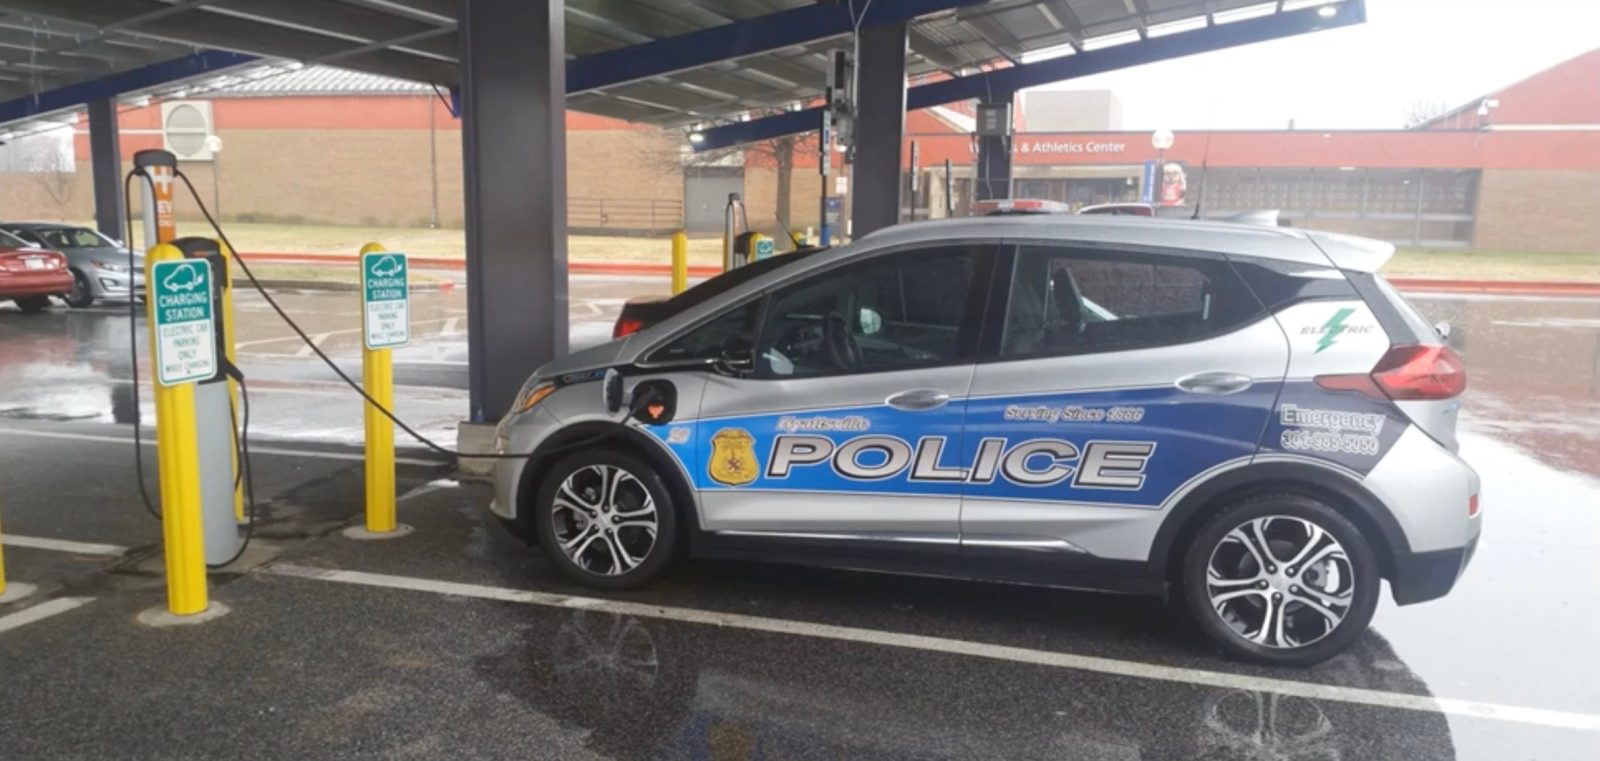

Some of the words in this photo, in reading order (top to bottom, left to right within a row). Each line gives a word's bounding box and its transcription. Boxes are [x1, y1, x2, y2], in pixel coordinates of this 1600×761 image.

[1032, 141, 1084, 154] Athletics
[1086, 142, 1126, 154] Center
[368, 278, 405, 289] CHARGING
[159, 290, 208, 308] CHARGING
[372, 289, 403, 300] STATION
[165, 305, 205, 322] STATION
[1004, 405, 1061, 424] Serving
[1061, 404, 1105, 422] Since
[1280, 403, 1386, 437] Emergency
[777, 415, 871, 433] Hyattsville
[763, 434, 1157, 491] POLICE
